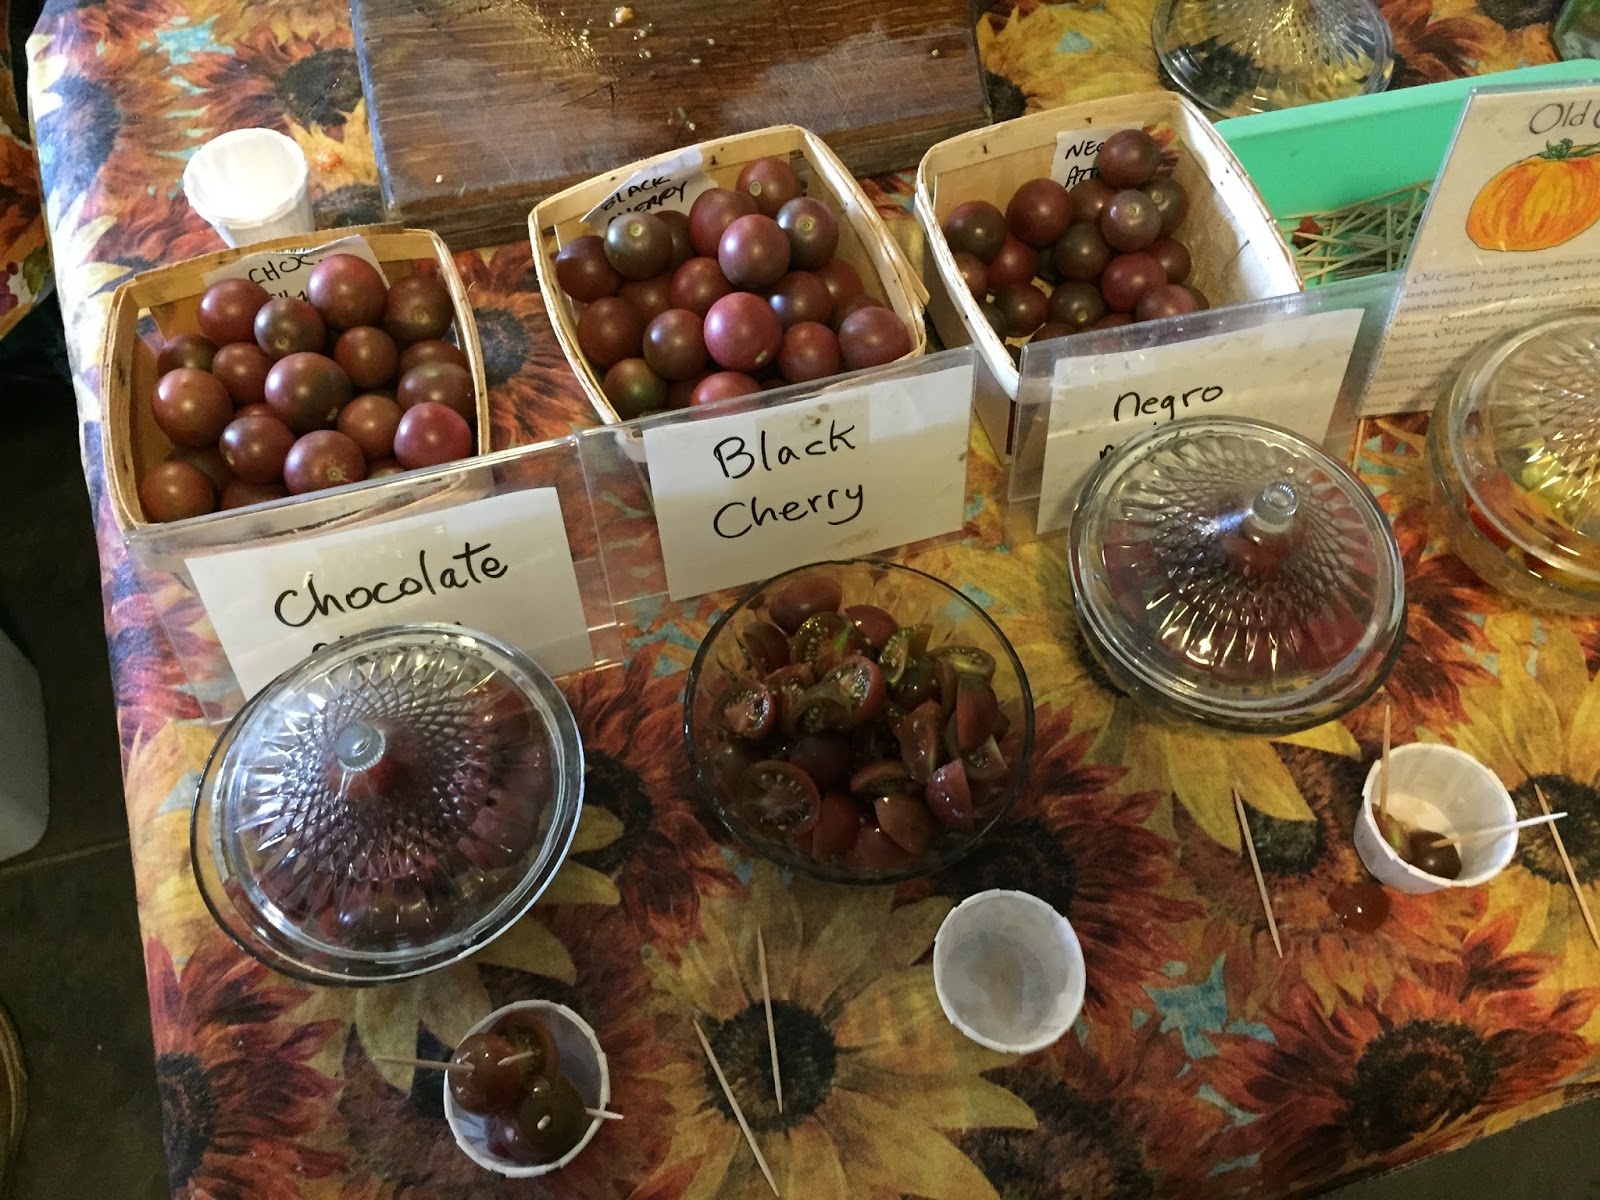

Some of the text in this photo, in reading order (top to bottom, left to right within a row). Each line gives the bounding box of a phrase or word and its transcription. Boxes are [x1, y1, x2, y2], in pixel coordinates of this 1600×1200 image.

[1529, 100, 1592, 134] Old
[600, 176, 671, 211] BLACK
[1065, 166, 1100, 188] AZT
[608, 181, 688, 225] ERRY
[713, 420, 855, 479] Black
[713, 484, 862, 538] Cherry
[274, 541, 508, 627] Chocolate
